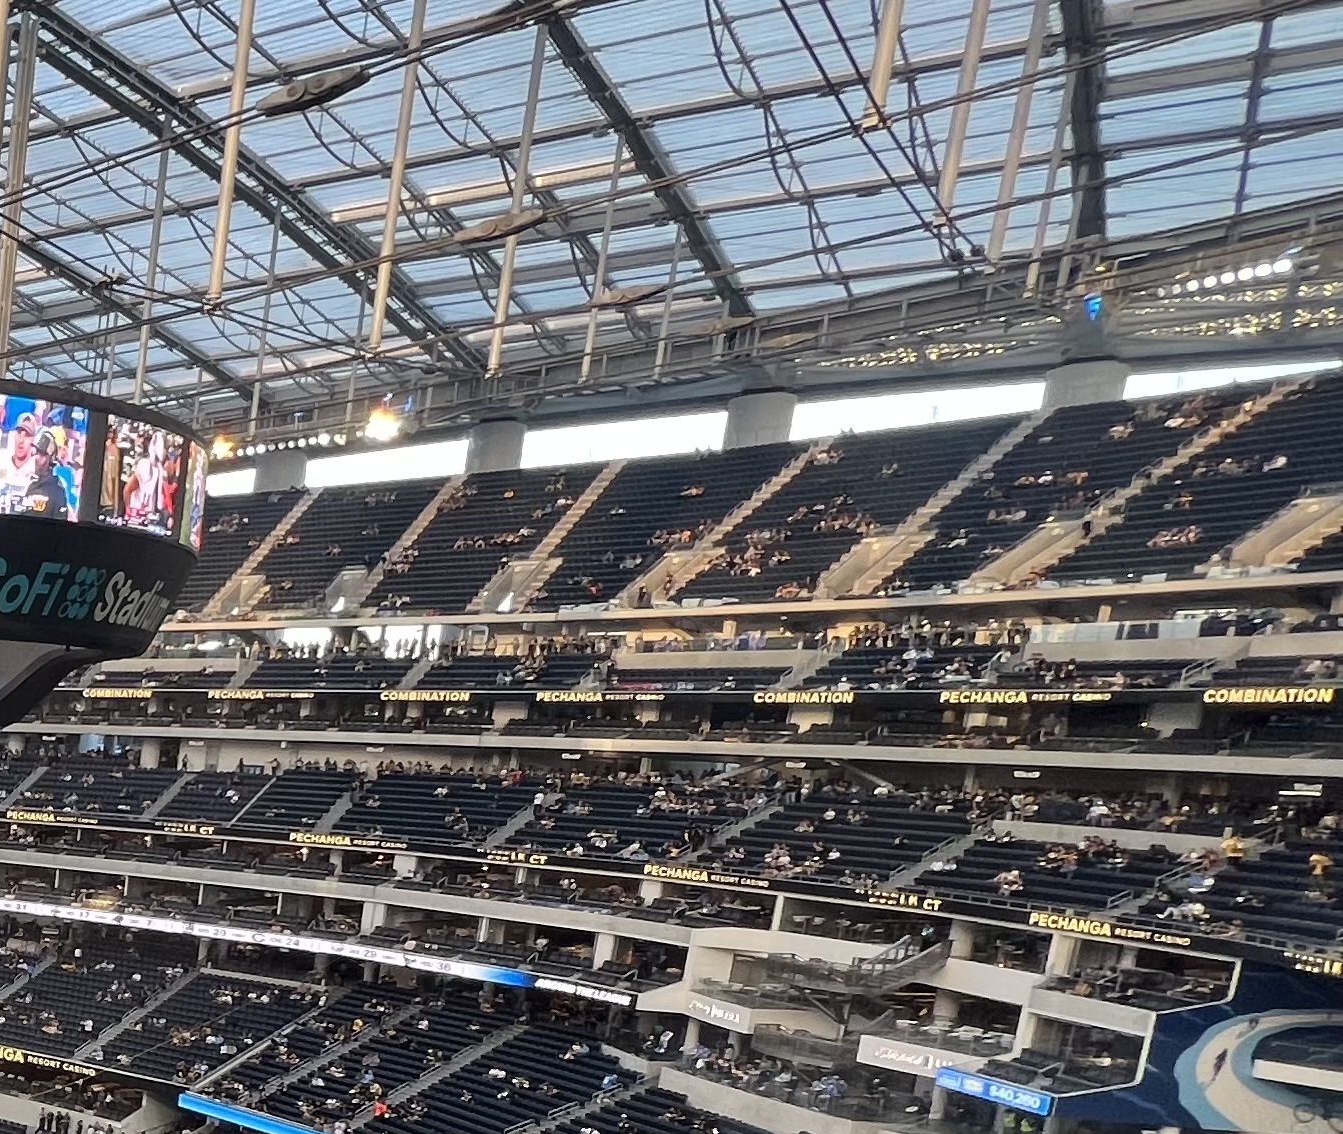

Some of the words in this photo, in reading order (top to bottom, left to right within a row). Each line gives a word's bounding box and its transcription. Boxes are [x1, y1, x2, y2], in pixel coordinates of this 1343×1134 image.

[82, 688, 153, 698] COMBINATION
[208, 690, 264, 699] PECHANGA
[380, 691, 471, 701] COMBINATION
[536, 692, 604, 701] PECHANGA
[753, 692, 854, 703] COMBINATION
[940, 691, 1028, 703] PECHANGA
[1203, 688, 1334, 703] COMBINATION
[7, 811, 56, 822] PECHANGA
[289, 832, 352, 846] PECHANGA
[644, 864, 709, 882] PECHANGA
[1029, 912, 1112, 937] PECHANGA
[1114, 927, 1152, 941] RESORT
[1153, 933, 1191, 946] CASINO
[27, 1055, 61, 1068] RESORT
[63, 1064, 96, 1077] CASINO
